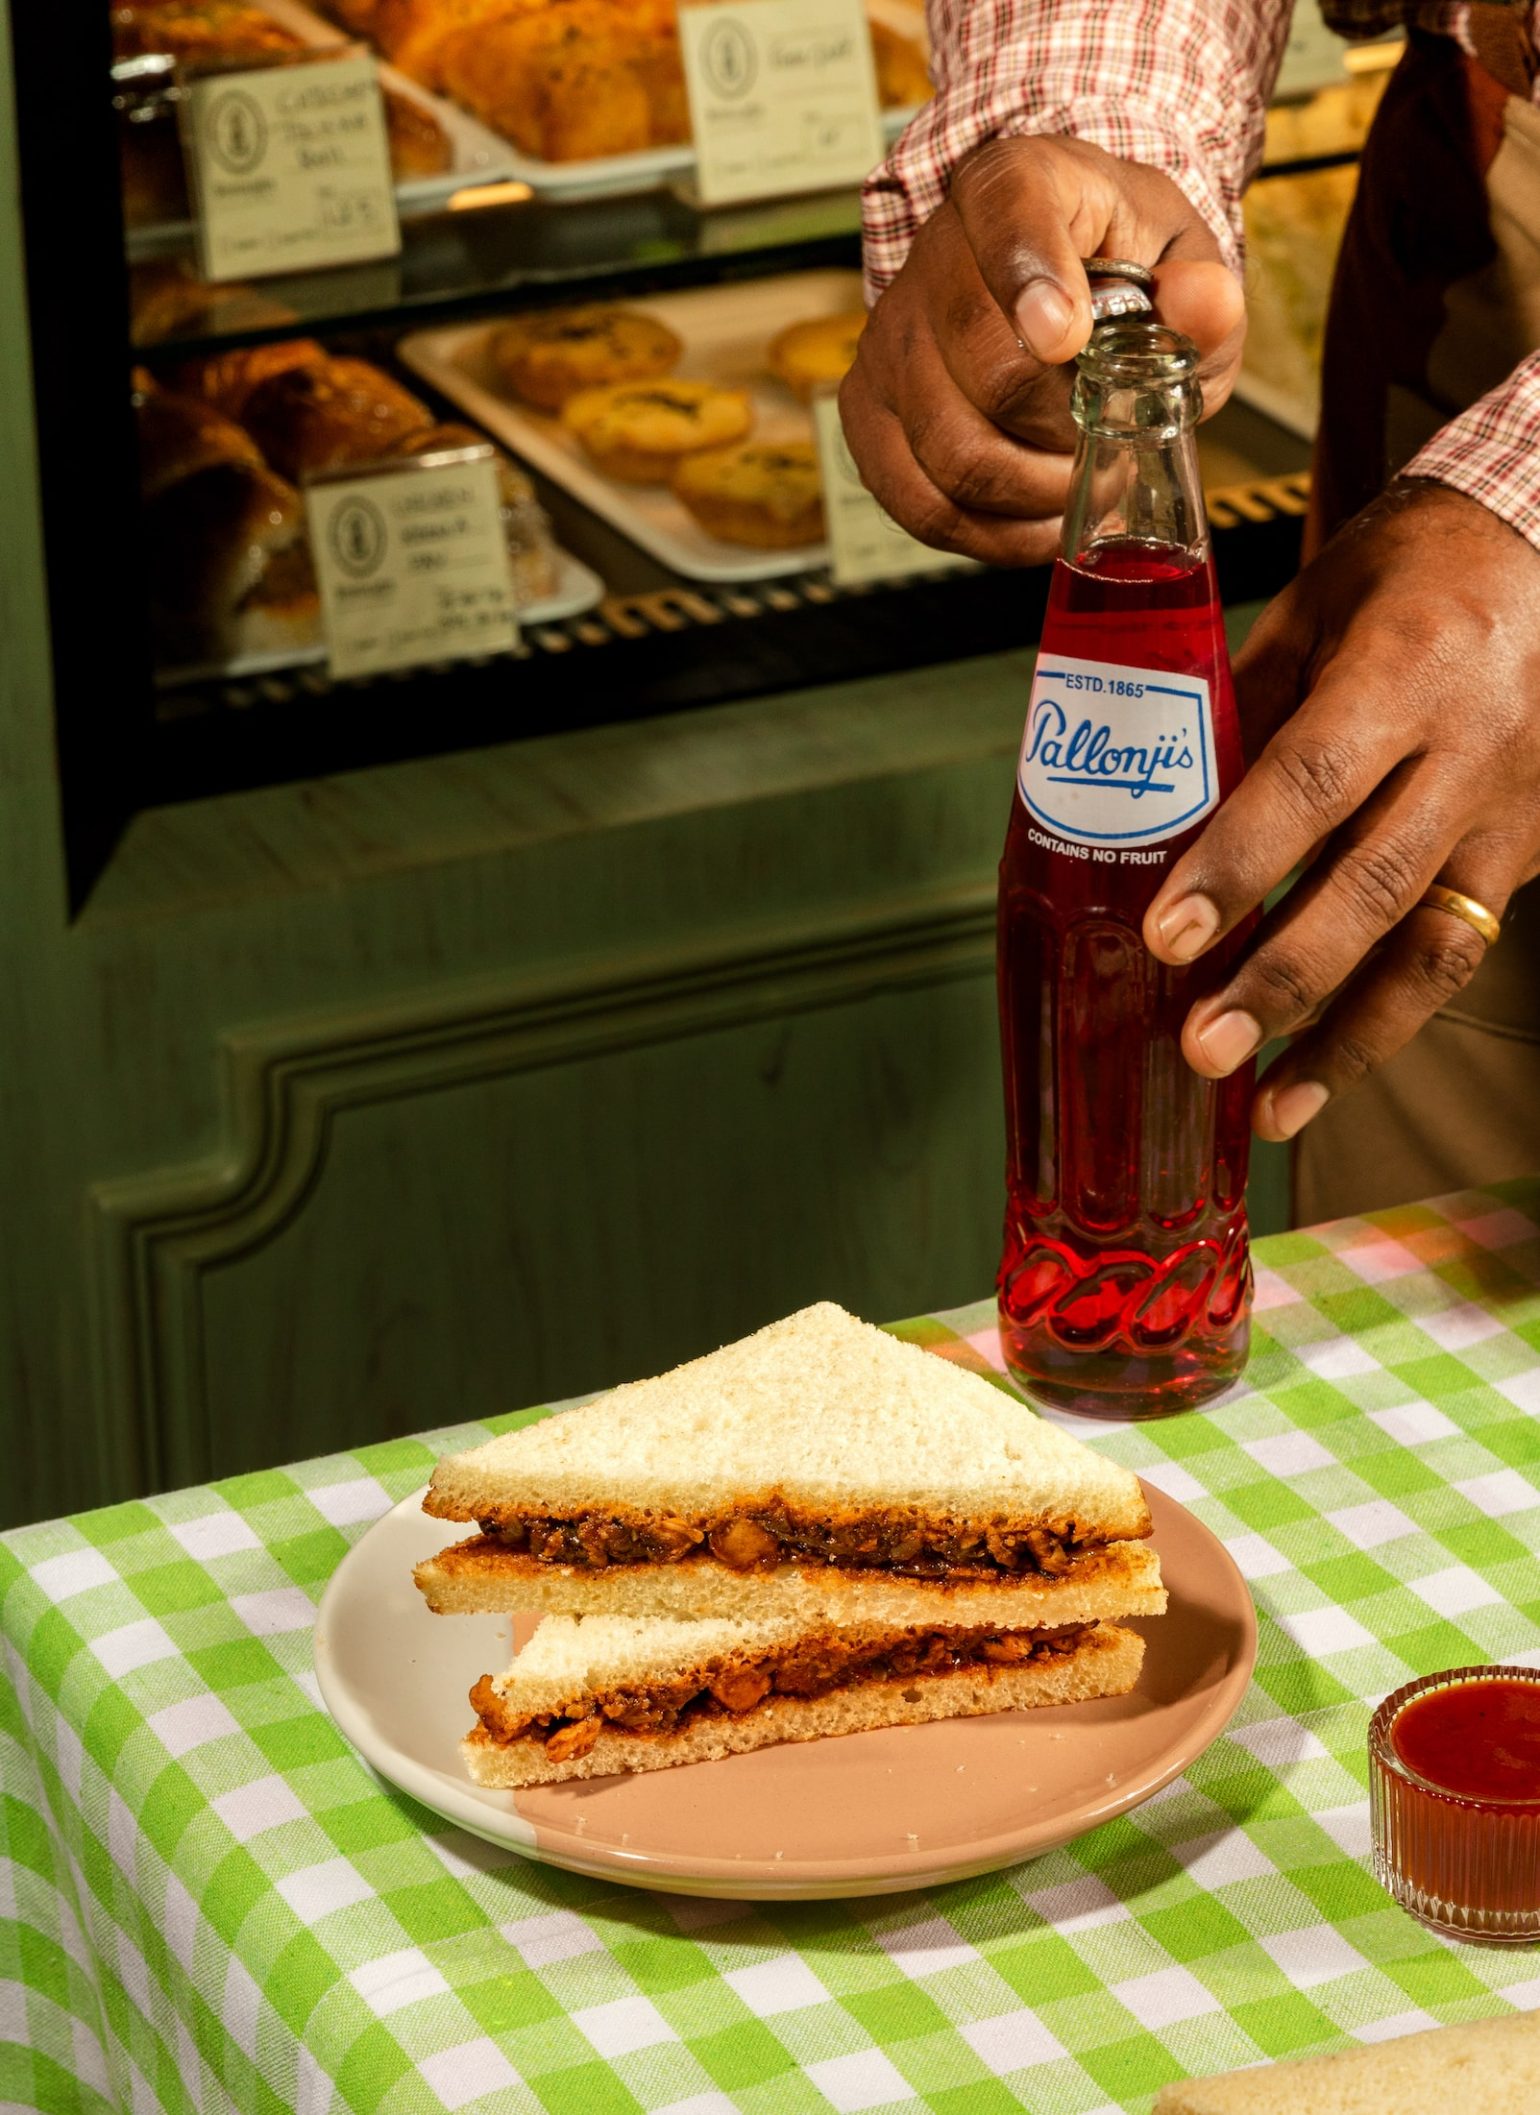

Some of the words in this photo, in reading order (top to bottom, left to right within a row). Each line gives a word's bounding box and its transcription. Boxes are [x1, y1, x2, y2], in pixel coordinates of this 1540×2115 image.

[1065, 673, 1144, 698] ESTD.1865
[1026, 699, 1193, 799] Pallonji's
[1027, 828, 1089, 860] CONTAINS
[1092, 848, 1117, 864] NO
[1119, 850, 1168, 865] FRUIT
